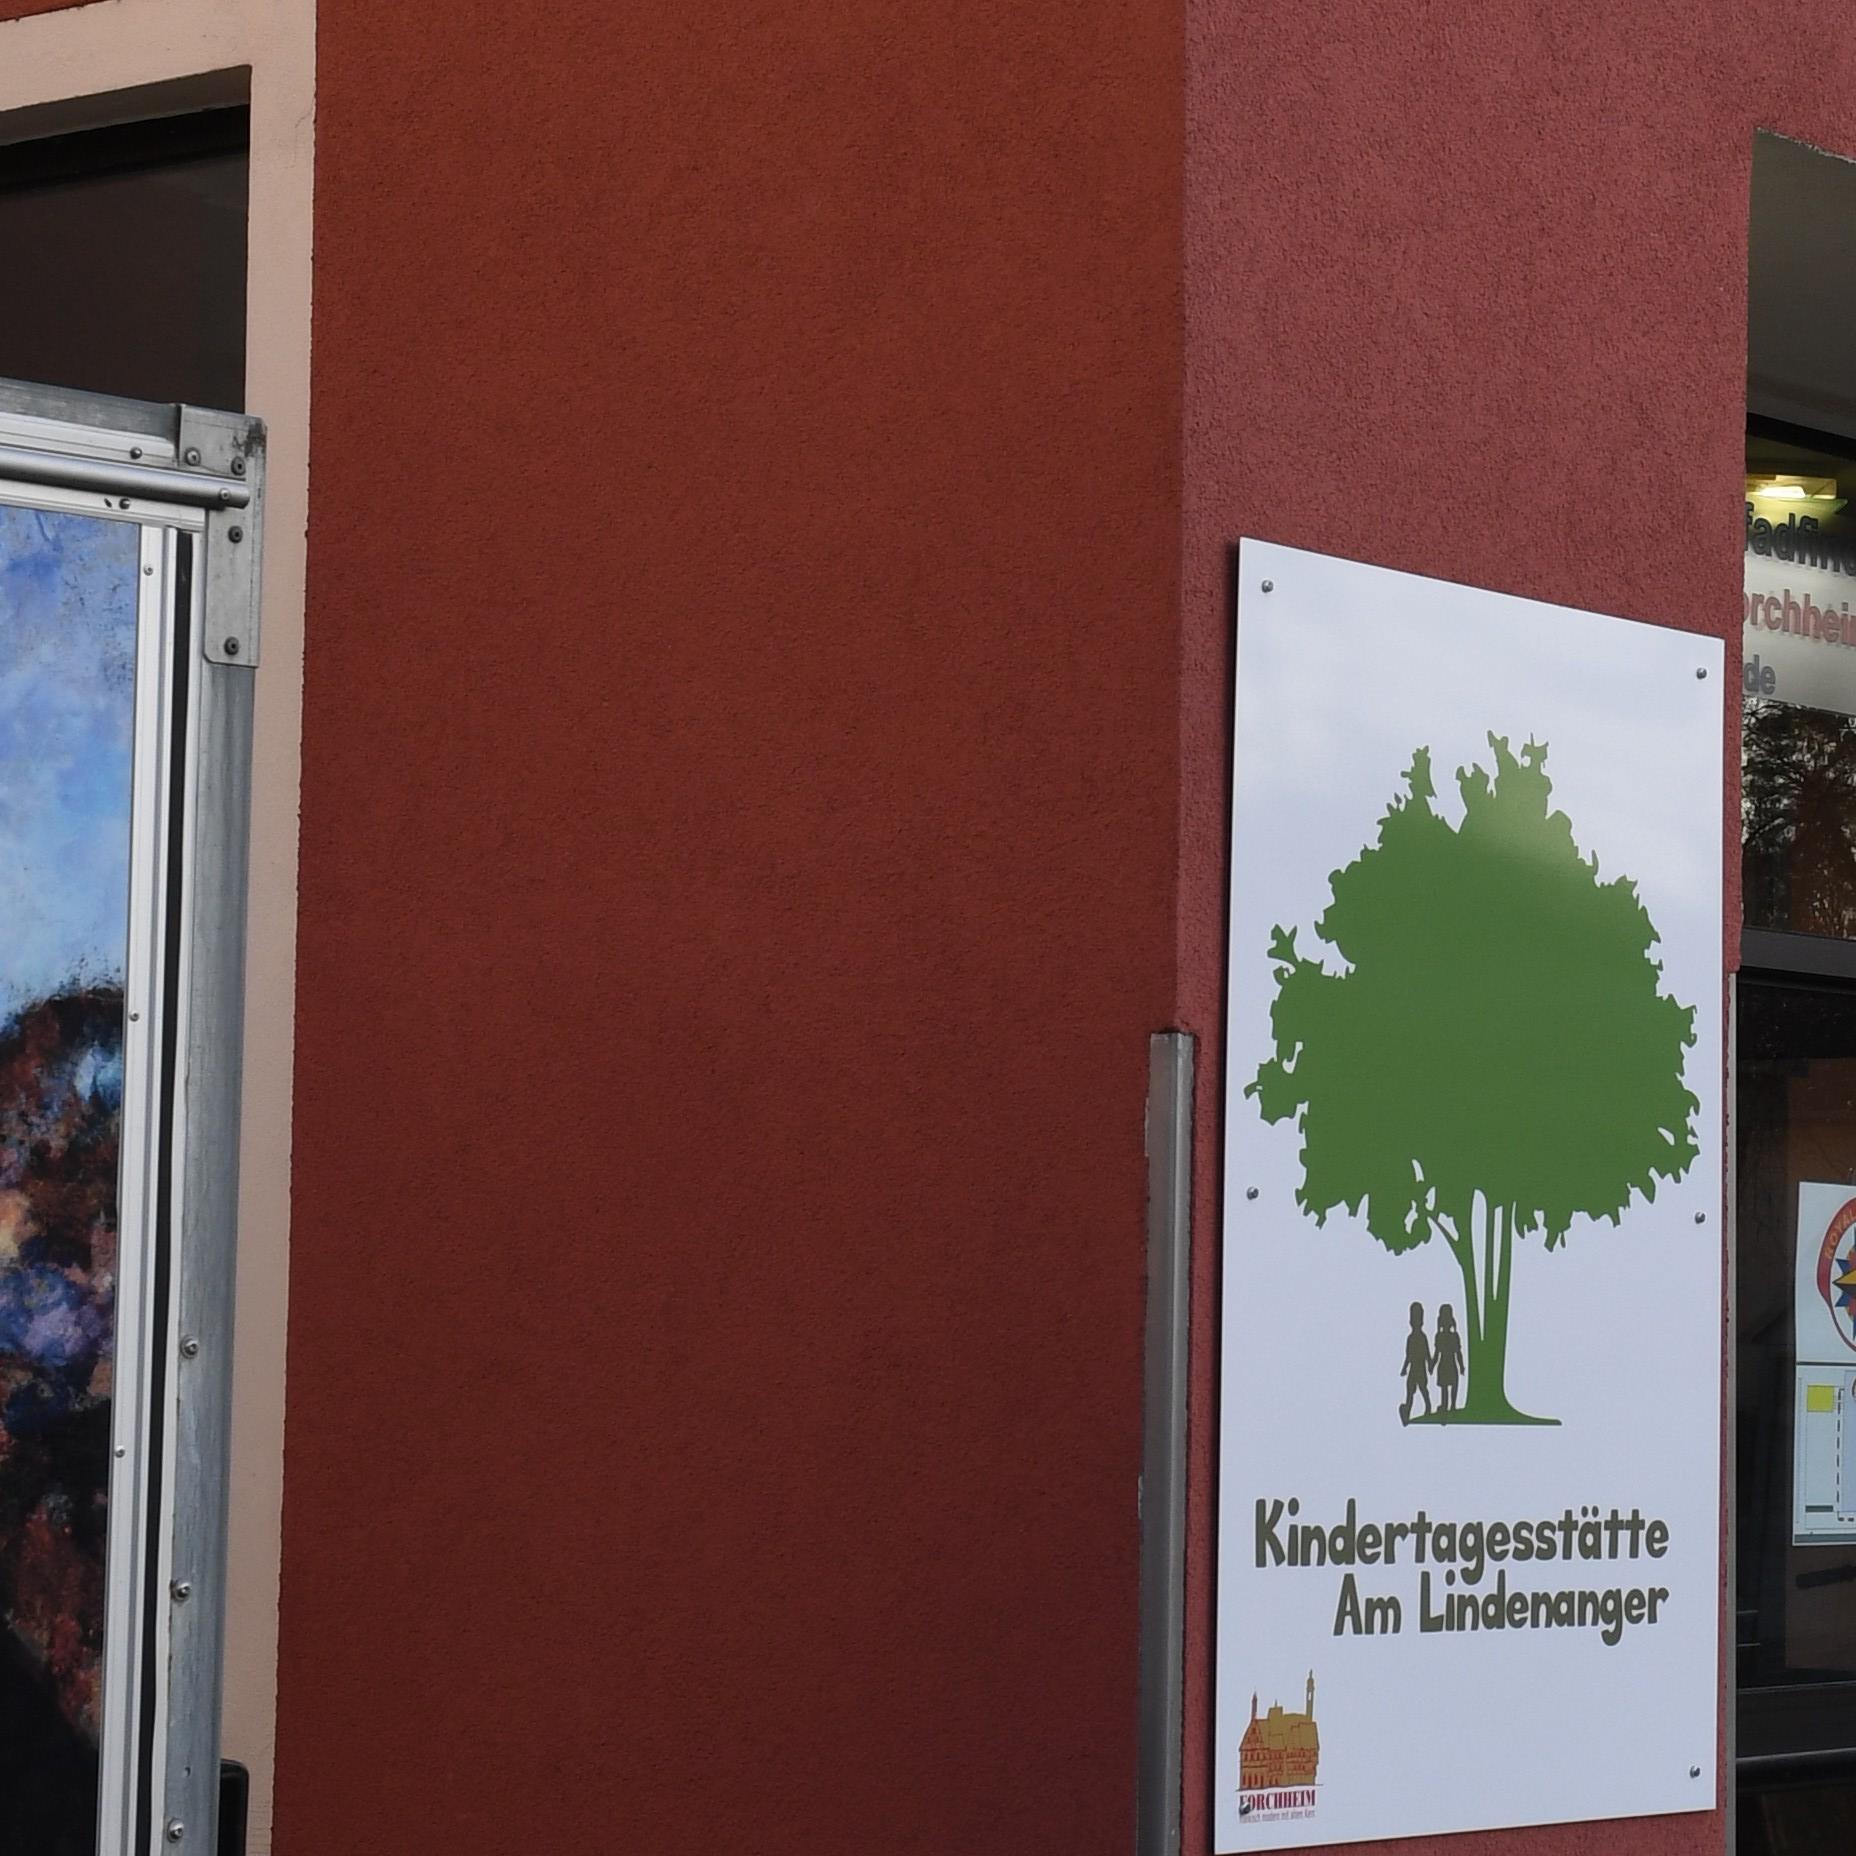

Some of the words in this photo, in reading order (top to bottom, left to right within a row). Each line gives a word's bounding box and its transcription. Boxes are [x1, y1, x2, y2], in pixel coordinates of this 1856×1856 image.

[1254, 1496, 1670, 1586] Kindertagesstätte
[1333, 1572, 1402, 1636] Am
[1419, 1568, 1670, 1646] Lindenanger
